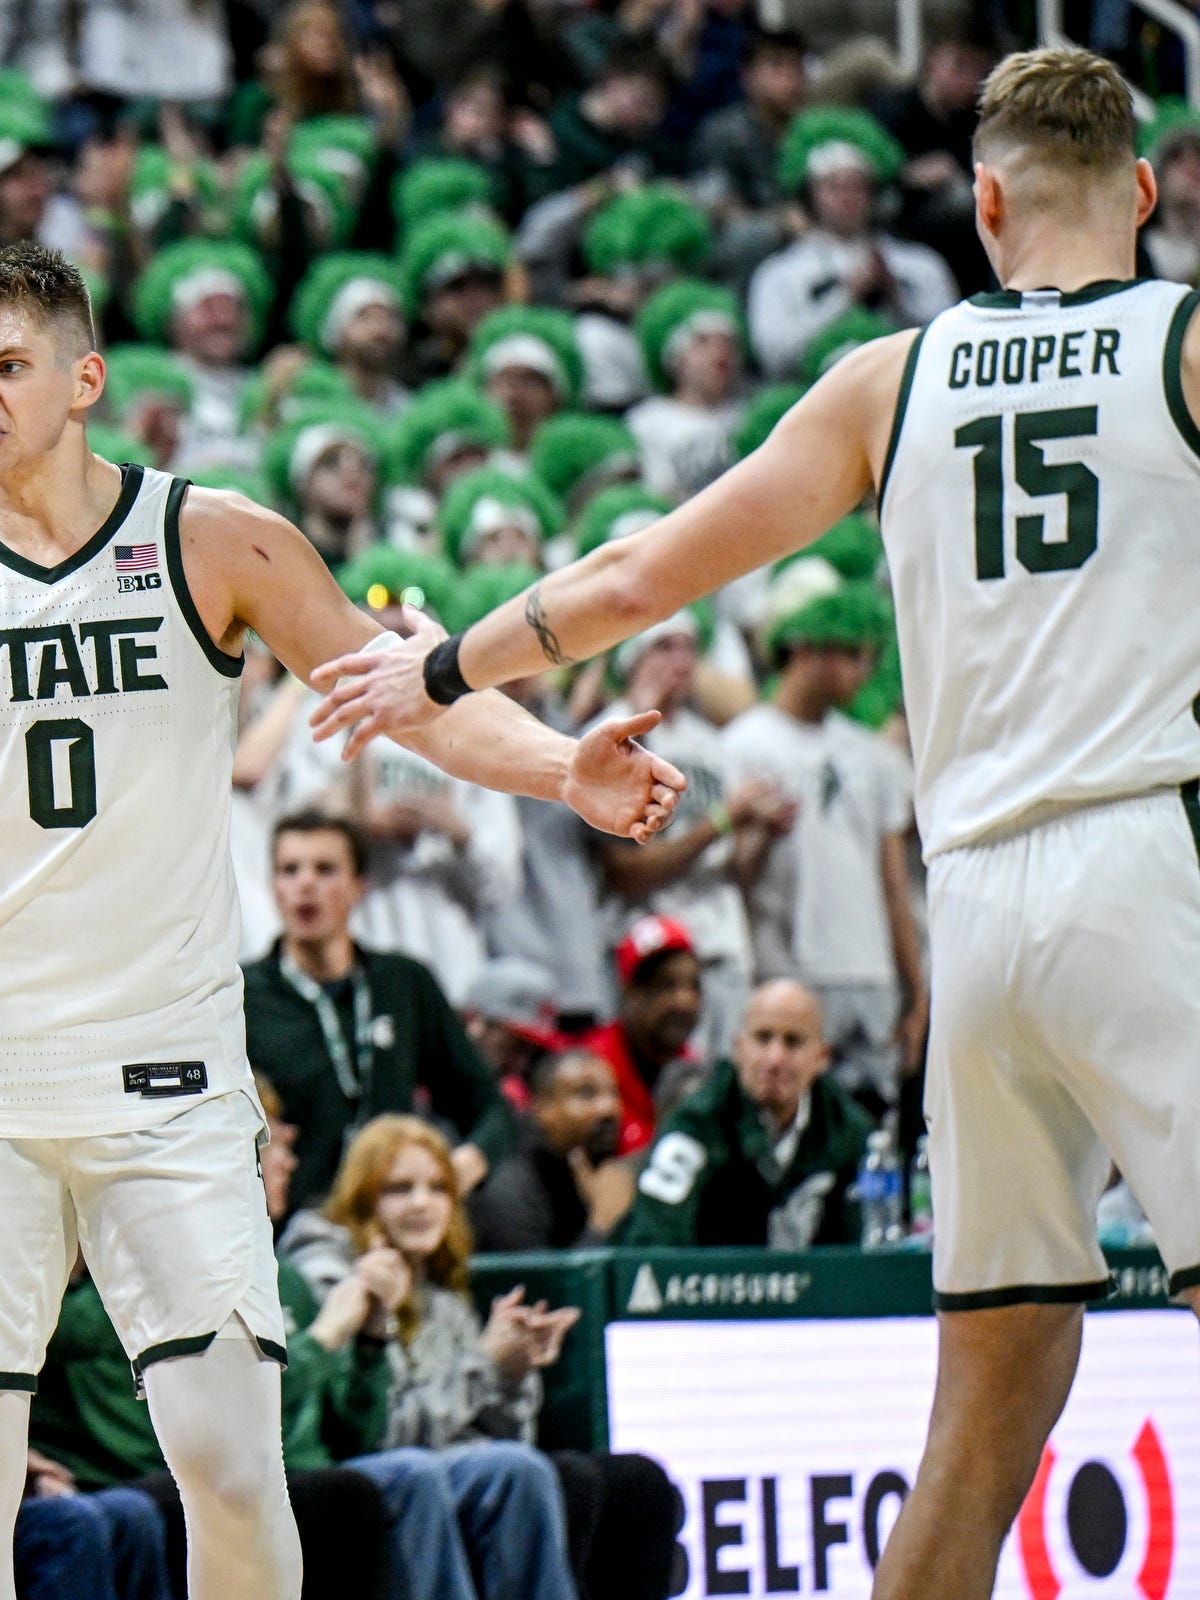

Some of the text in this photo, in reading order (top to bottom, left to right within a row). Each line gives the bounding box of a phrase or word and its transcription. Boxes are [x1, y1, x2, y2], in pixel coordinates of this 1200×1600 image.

[948, 328, 1121, 389] COOPER
[954, 404, 1100, 581] 15
[24, 718, 98, 830] 0
[186, 1069, 201, 1080] 48
[639, 1131, 707, 1204] S
